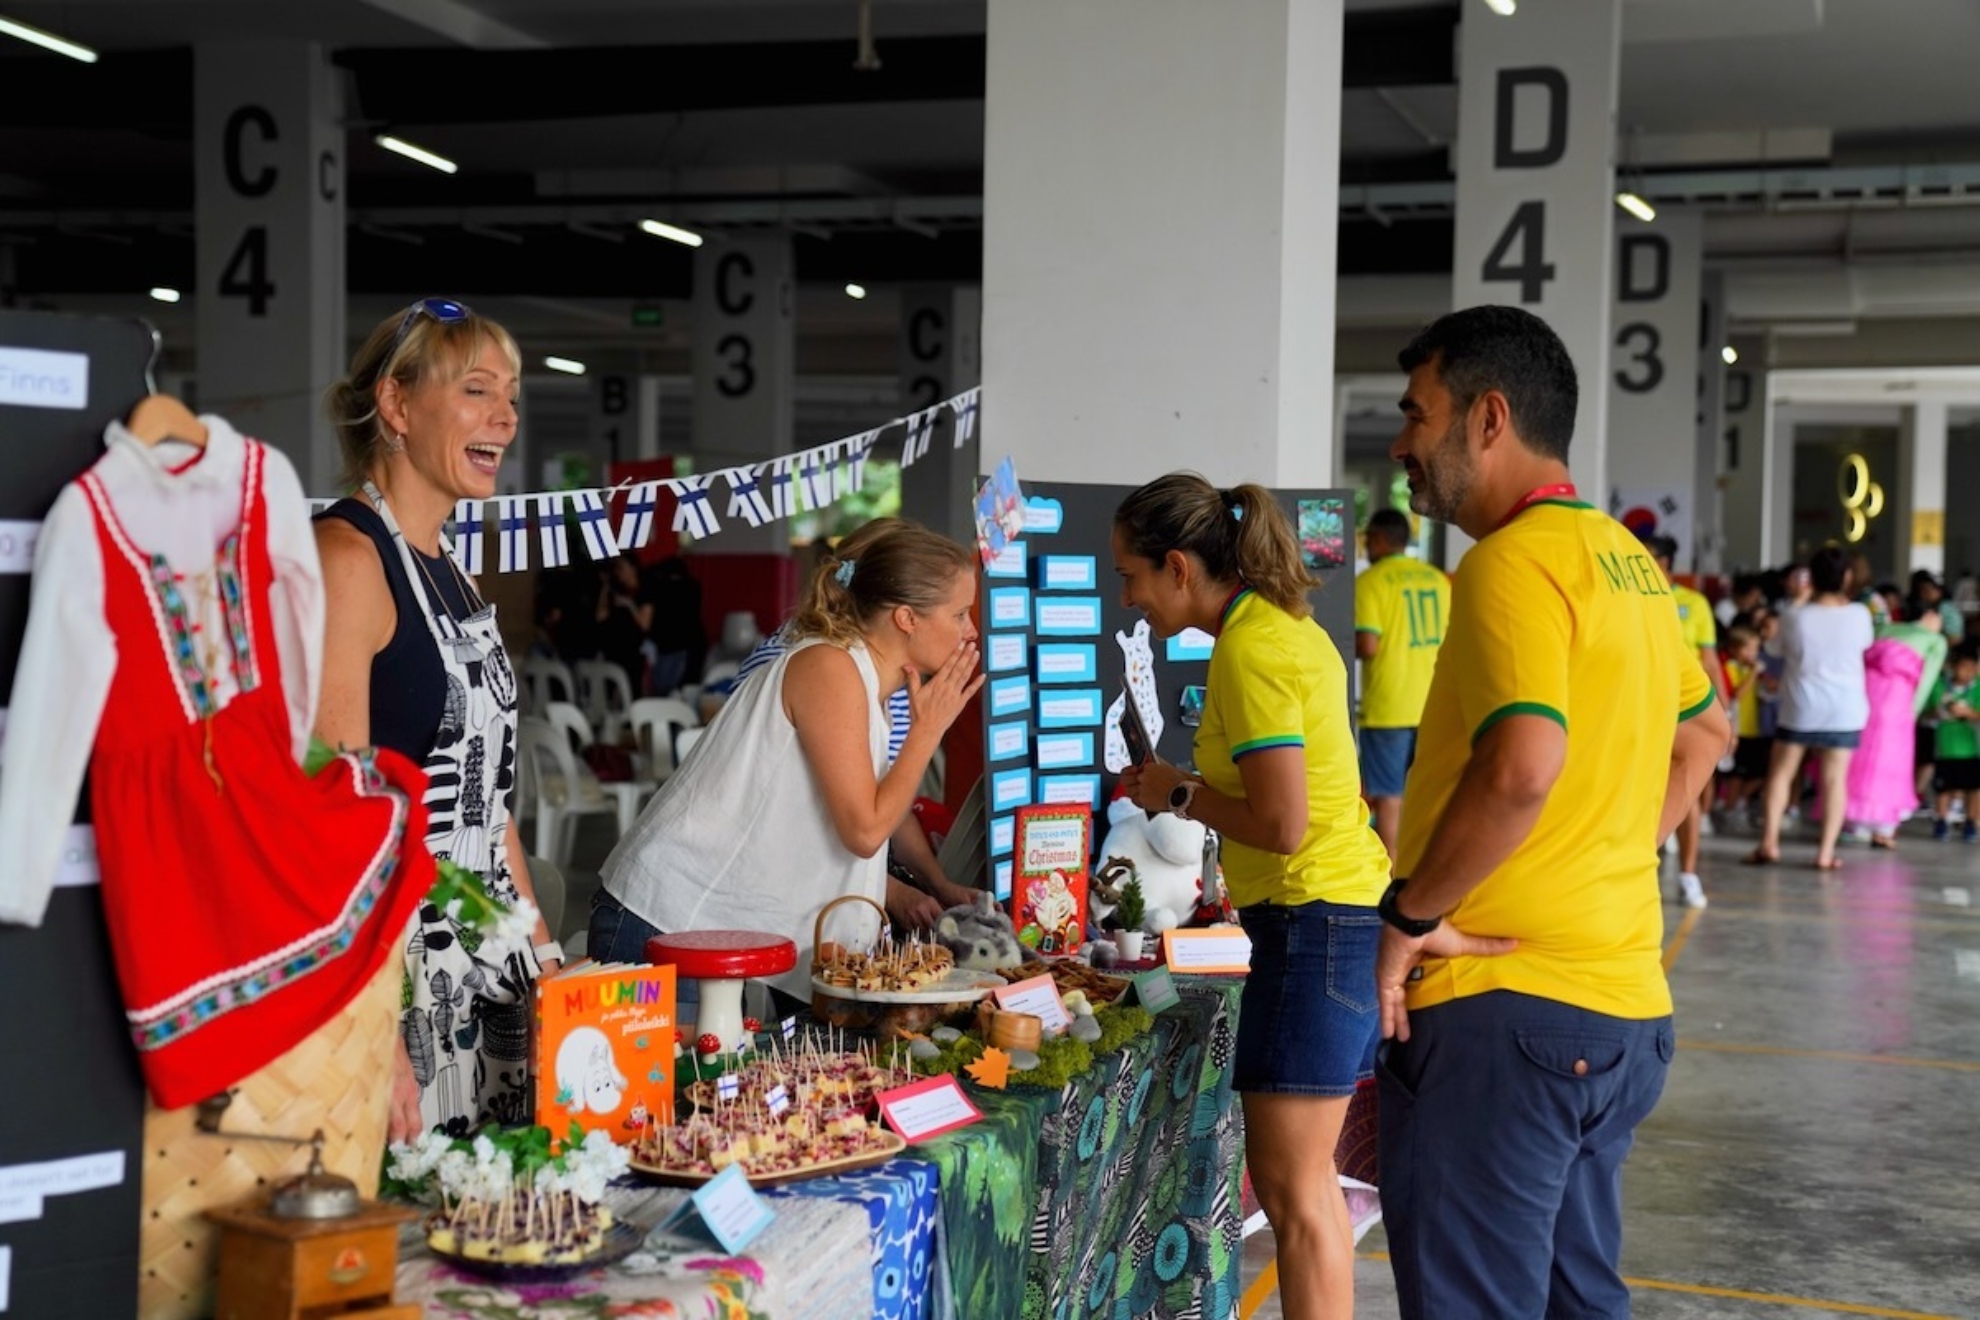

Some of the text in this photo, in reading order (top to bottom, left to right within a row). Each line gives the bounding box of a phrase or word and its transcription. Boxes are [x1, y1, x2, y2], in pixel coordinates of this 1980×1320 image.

[1494, 65, 1570, 169] D
[222, 104, 279, 198] C
[318, 149, 338, 203] C
[217, 225, 276, 317] 4
[1481, 200, 1556, 304] 4
[1618, 232, 1671, 303] D
[713, 250, 755, 317] C
[909, 306, 943, 361] C
[1614, 321, 1665, 394] 3
[602, 375, 628, 415] B
[715, 333, 756, 399] 3
[1725, 371, 1752, 414] D
[605, 427, 621, 462] 1
[1724, 425, 1741, 471] 1
[1402, 589, 1440, 648] 10
[1029, 849, 1077, 867] Christmas
[565, 980, 661, 1017] MUUMIN
